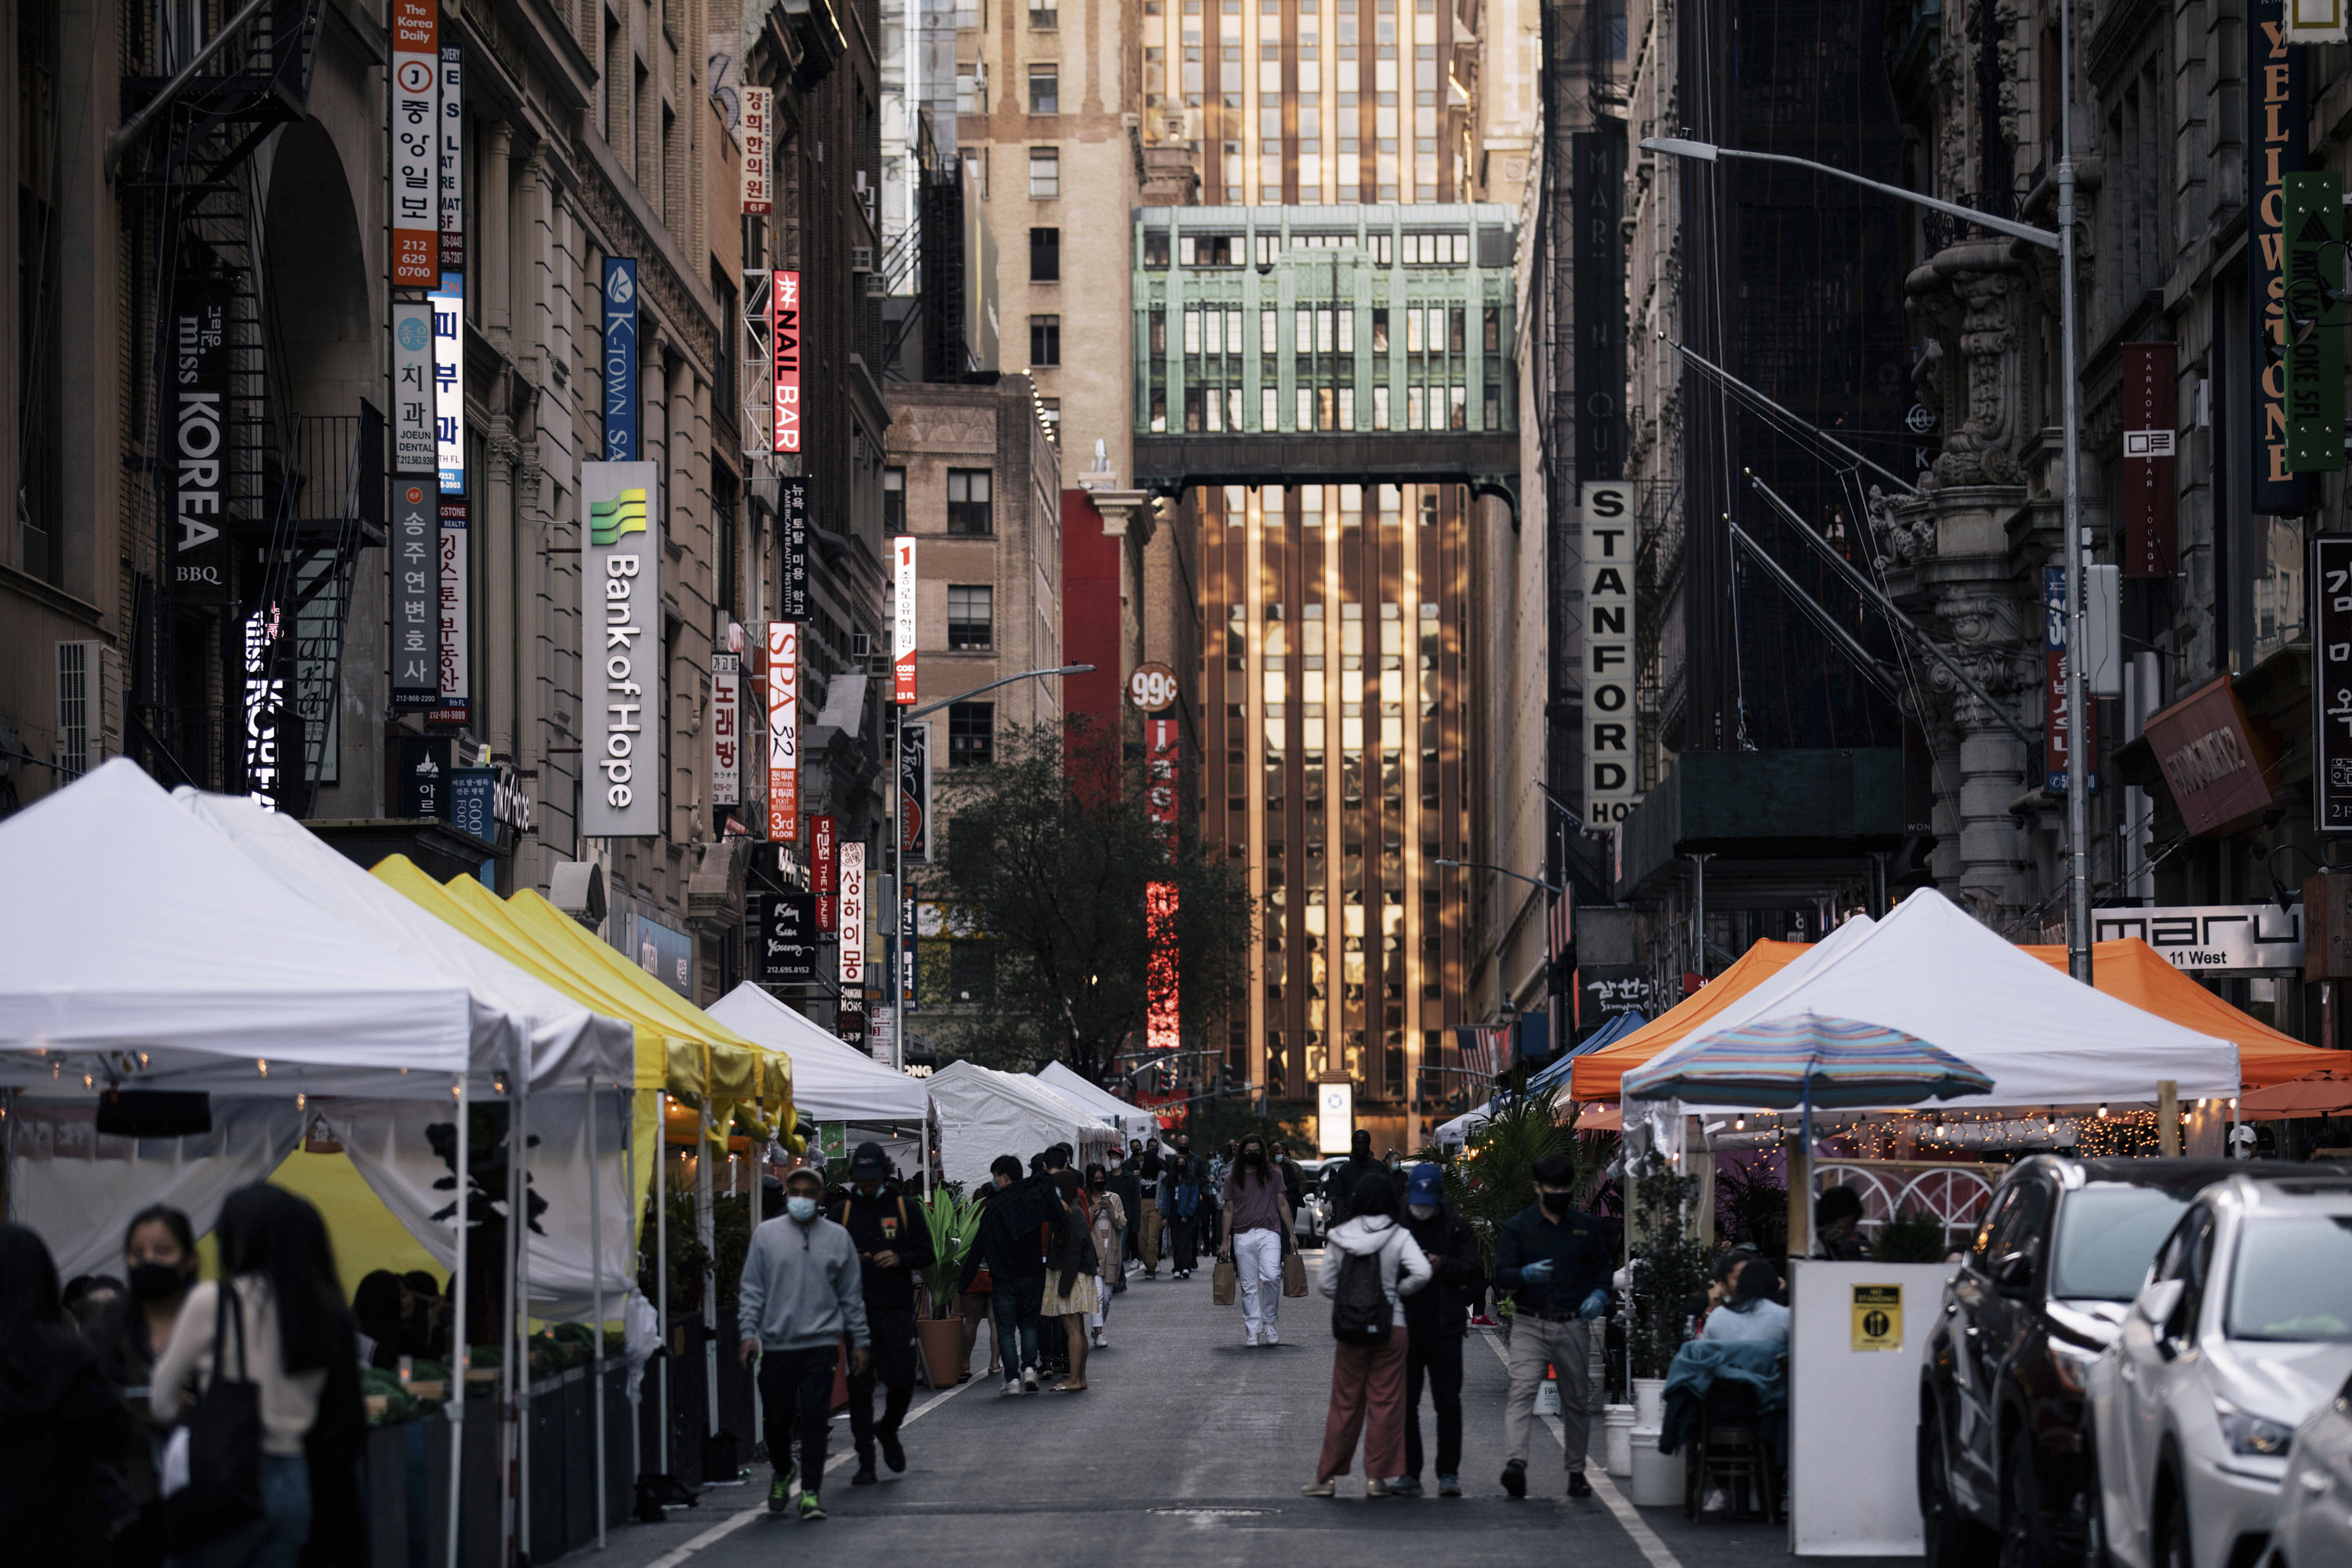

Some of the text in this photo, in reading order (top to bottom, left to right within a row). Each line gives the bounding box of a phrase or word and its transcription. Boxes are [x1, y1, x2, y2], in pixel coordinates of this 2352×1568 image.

[405, 4, 426, 16] The
[397, 16, 433, 28] Korea
[400, 30, 430, 44] Daily
[411, 70, 419, 85] J
[746, 92, 764, 198] 경희한의원
[401, 100, 430, 219] 중앙일보
[403, 240, 426, 251] 212
[402, 254, 426, 263] 629
[398, 267, 430, 278] 0700
[399, 325, 428, 344] 좋은
[777, 310, 797, 380] NAIL
[2293, 289, 2319, 383] KAAOKE
[608, 310, 634, 416] K-TOWN
[401, 362, 426, 429] 치과
[776, 386, 798, 448] BAR
[178, 314, 220, 552] miss KOREA
[401, 430, 431, 439] JOEUN
[399, 443, 434, 452] DENTAL
[176, 566, 221, 585] BBQ
[792, 554, 804, 580] 미용
[1592, 490, 1627, 790] STANFORD
[600, 554, 641, 808] Bank of Hope
[770, 632, 795, 713] SPA
[715, 677, 736, 768] 노래방
[771, 812, 793, 829] 3rd
[816, 820, 829, 860] 더큰집
[774, 903, 800, 922] Kim
[775, 924, 797, 936] Sun
[842, 870, 862, 979] 상하이몽
[2096, 914, 2299, 946] maru
[768, 938, 815, 956] Young
[2169, 951, 2227, 964] 11 West
